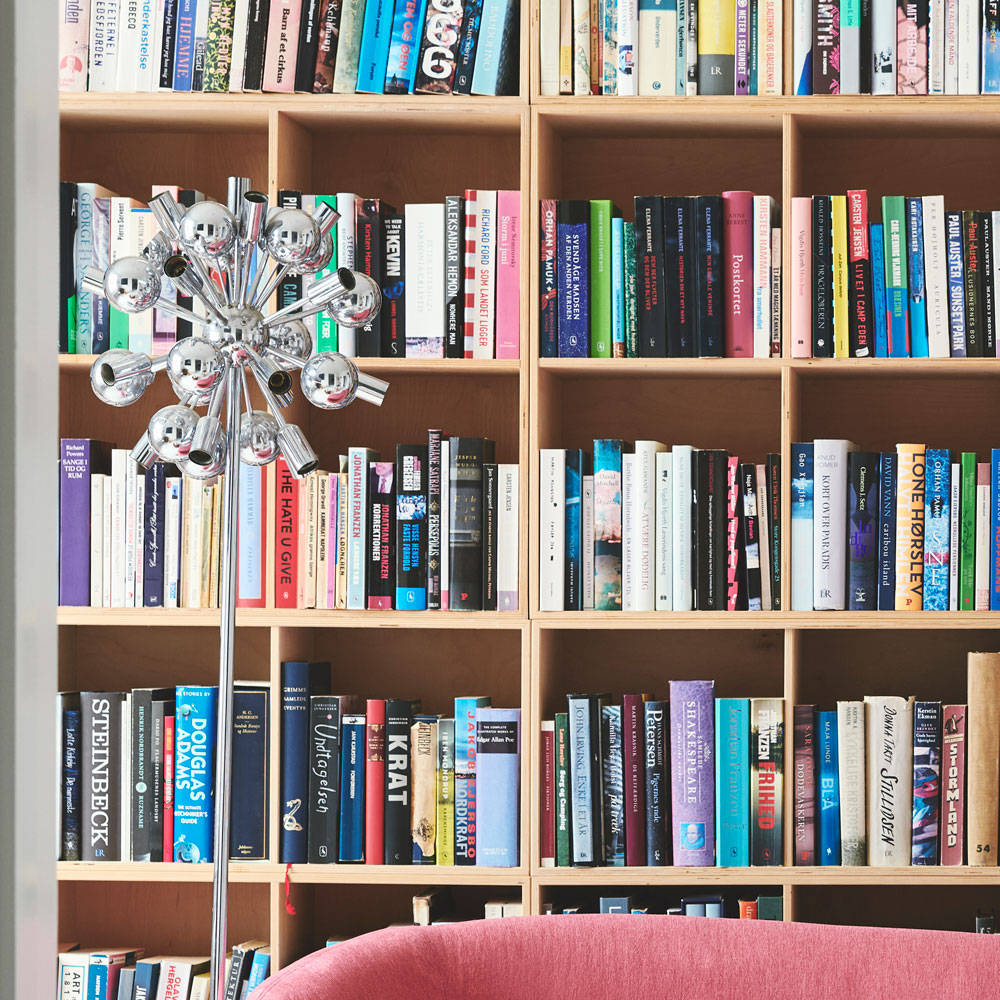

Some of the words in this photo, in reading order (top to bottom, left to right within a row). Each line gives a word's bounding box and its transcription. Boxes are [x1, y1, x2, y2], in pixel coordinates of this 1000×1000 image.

[281, 8, 291, 30] Barn
[322, 3, 338, 52] Kehlmann
[402, 21, 413, 40] OG
[907, 4, 917, 22] MIT
[176, 16, 192, 79] HJEMME
[279, 31, 287, 42] af
[279, 44, 286, 52] et
[482, 6, 500, 72] BAUDOLINO
[907, 25, 917, 74] ARBEJDE
[195, 41, 205, 71] Gilead
[276, 55, 286, 83] cirkus
[399, 44, 411, 70] ØEN
[79, 193, 92, 246] GEORGE
[447, 200, 458, 261] ALEKSANDAR
[481, 208, 491, 243] RICHARD
[545, 211, 554, 246] ORHAN
[948, 215, 959, 239] PAUL
[968, 223, 978, 241] Paul
[387, 235, 401, 277] KEVIN
[480, 245, 491, 265] FORD
[545, 250, 554, 284] PAMUK
[573, 265, 582, 281] ÅGE
[950, 242, 961, 278] AUSTER
[968, 245, 978, 272] Auster
[447, 266, 458, 297] HEMON
[480, 269, 489, 286] SOM
[731, 255, 745, 316] Postkortet
[79, 264, 92, 335] SANDERS
[448, 304, 457, 331] NOWHERE
[480, 289, 489, 318] LANDET
[573, 285, 581, 320] MADSEN
[951, 287, 963, 322] SUNSET
[449, 333, 457, 345] MAN
[479, 321, 488, 347] LIGGER
[953, 326, 964, 350] PARK
[281, 469, 293, 492] THE
[353, 454, 362, 498] JONATHAN
[911, 453, 923, 503] LONE
[281, 497, 293, 533] HATE
[352, 501, 361, 538] FRANZEN
[372, 504, 381, 561] KORREKTIONER
[381, 504, 389, 543] JONATHAN
[281, 537, 292, 546] U
[909, 509, 924, 595] HØRSLEV
[928, 530, 945, 586] SNE
[280, 550, 292, 584] GIVE
[381, 545, 389, 579] FRANZEN
[467, 711, 475, 770] JAKOB
[646, 709, 663, 768] Petersen
[729, 706, 741, 759] Jonathan
[758, 709, 769, 759] FRANZEN
[176, 728, 193, 790] ADAMS
[190, 718, 207, 801] DOUGLAS
[313, 724, 338, 813] Undtagelsen
[388, 734, 408, 805] KRAT
[686, 701, 697, 804] SHAKESPEARE
[91, 698, 110, 847] STEINBECK
[730, 763, 741, 817] Franzen
[758, 763, 775, 829] FRIHED
[797, 764, 806, 841] DØDEVASKEREN
[821, 778, 837, 810] BLÅ
[945, 743, 960, 848] STORMLAND
[456, 779, 468, 858] NORDKRAFT
[467, 780, 475, 858] EJERSBO
[976, 844, 991, 854] 54
[72, 972, 82, 994] ART
[164, 965, 177, 1000] HERGEL
